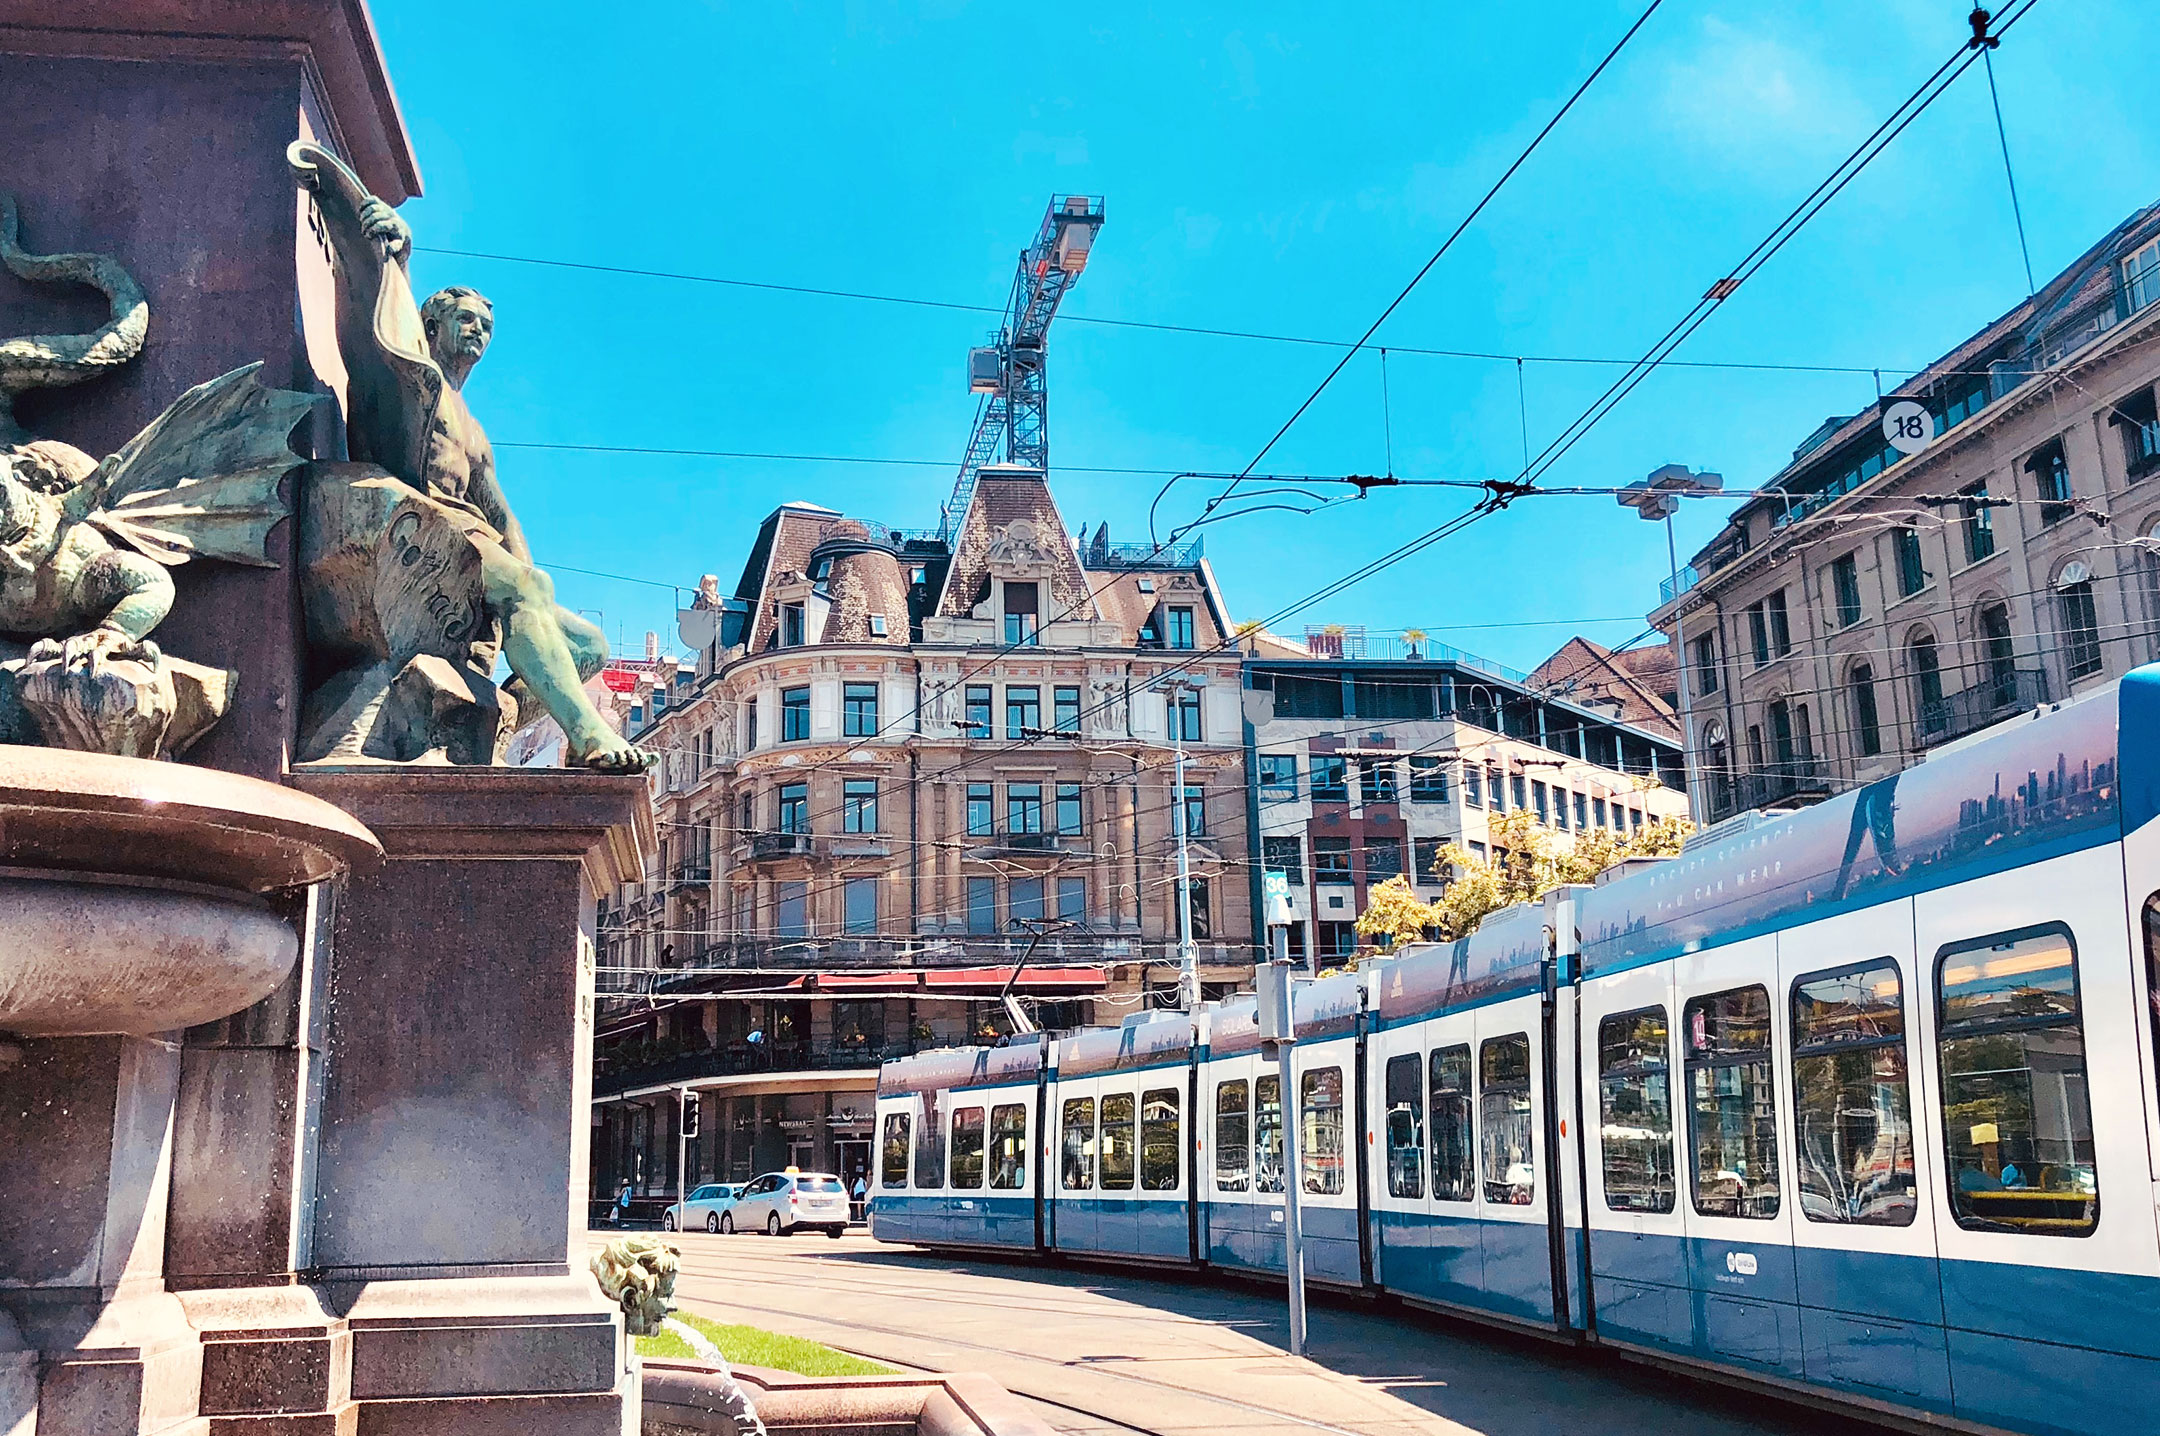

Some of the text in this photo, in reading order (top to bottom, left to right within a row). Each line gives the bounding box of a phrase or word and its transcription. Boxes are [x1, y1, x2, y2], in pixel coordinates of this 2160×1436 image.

[1893, 416, 1924, 439] 18
[1718, 824, 1794, 862] SCIENCE
[1266, 876, 1289, 894] 36
[1694, 880, 1723, 901] CAN
[1736, 861, 1782, 887] WEAR
